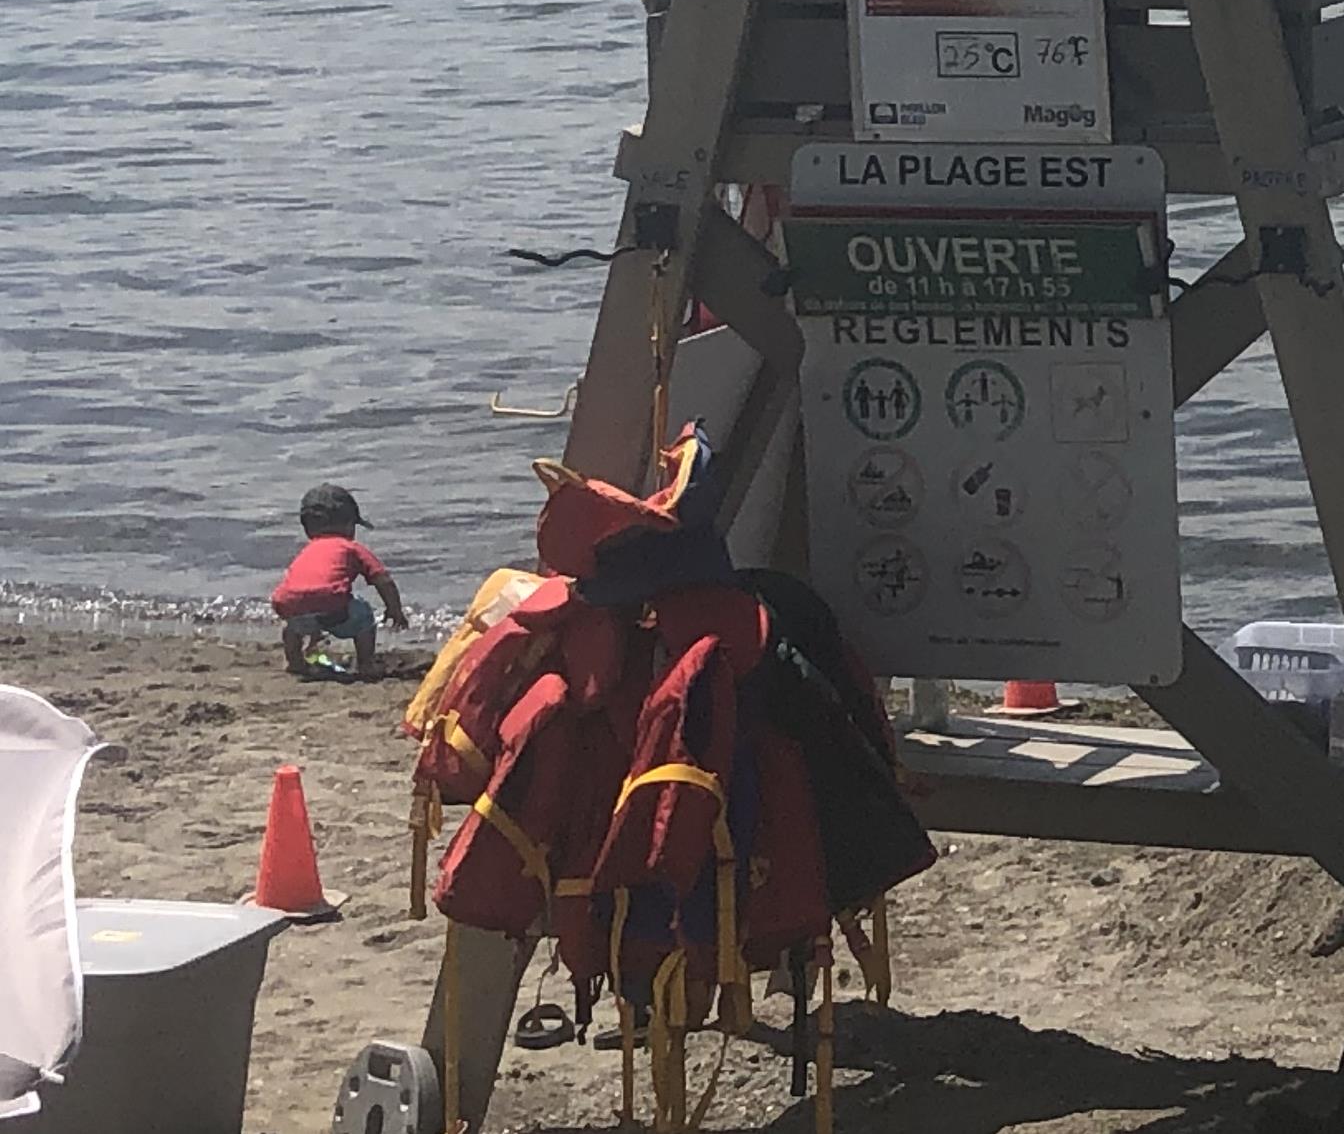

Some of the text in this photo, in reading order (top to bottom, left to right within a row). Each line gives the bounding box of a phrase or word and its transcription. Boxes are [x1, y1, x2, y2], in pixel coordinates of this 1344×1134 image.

[839, 154, 1113, 188] LA PLAGE EST
[847, 233, 1083, 274] OUVERTE
[868, 275, 897, 296] de
[906, 276, 930, 296] 11
[938, 276, 955, 296] h
[983, 277, 1010, 297] 17
[1019, 277, 1035, 297] h
[1042, 277, 1071, 297] 55
